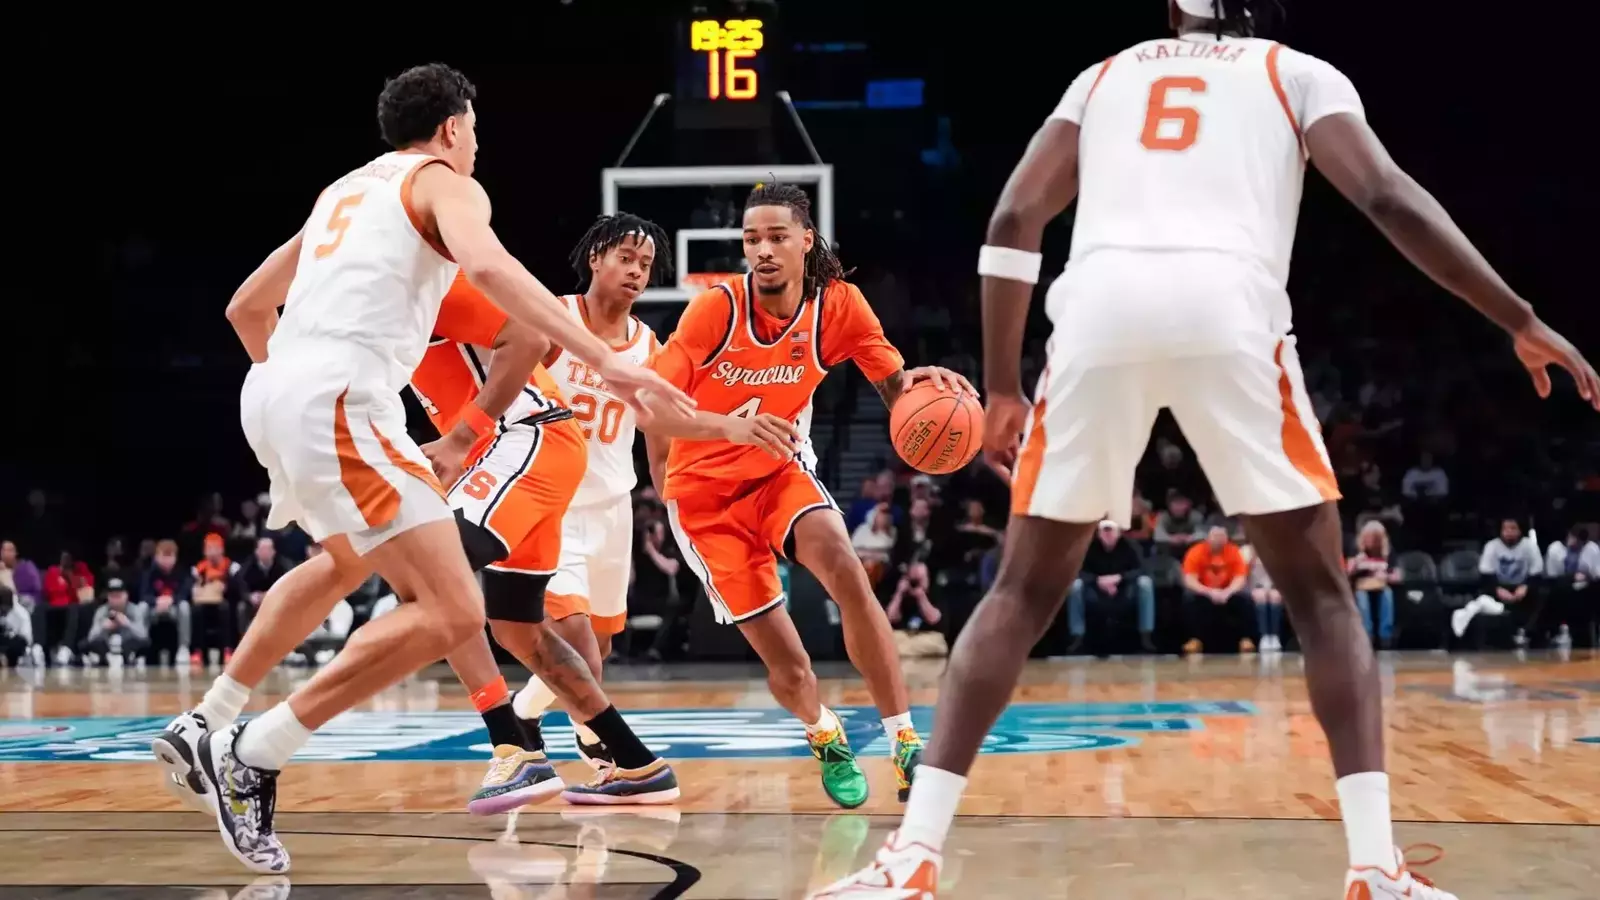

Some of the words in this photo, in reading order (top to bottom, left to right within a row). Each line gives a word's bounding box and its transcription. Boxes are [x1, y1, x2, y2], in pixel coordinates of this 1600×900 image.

[708, 49, 757, 99] 16
[1139, 75, 1208, 152] 6
[314, 191, 366, 260] 5
[711, 361, 805, 387] Syracuse
[571, 392, 626, 445] 20
[727, 396, 763, 419] 4
[907, 420, 938, 460] LEGAC
[462, 470, 498, 501] S
